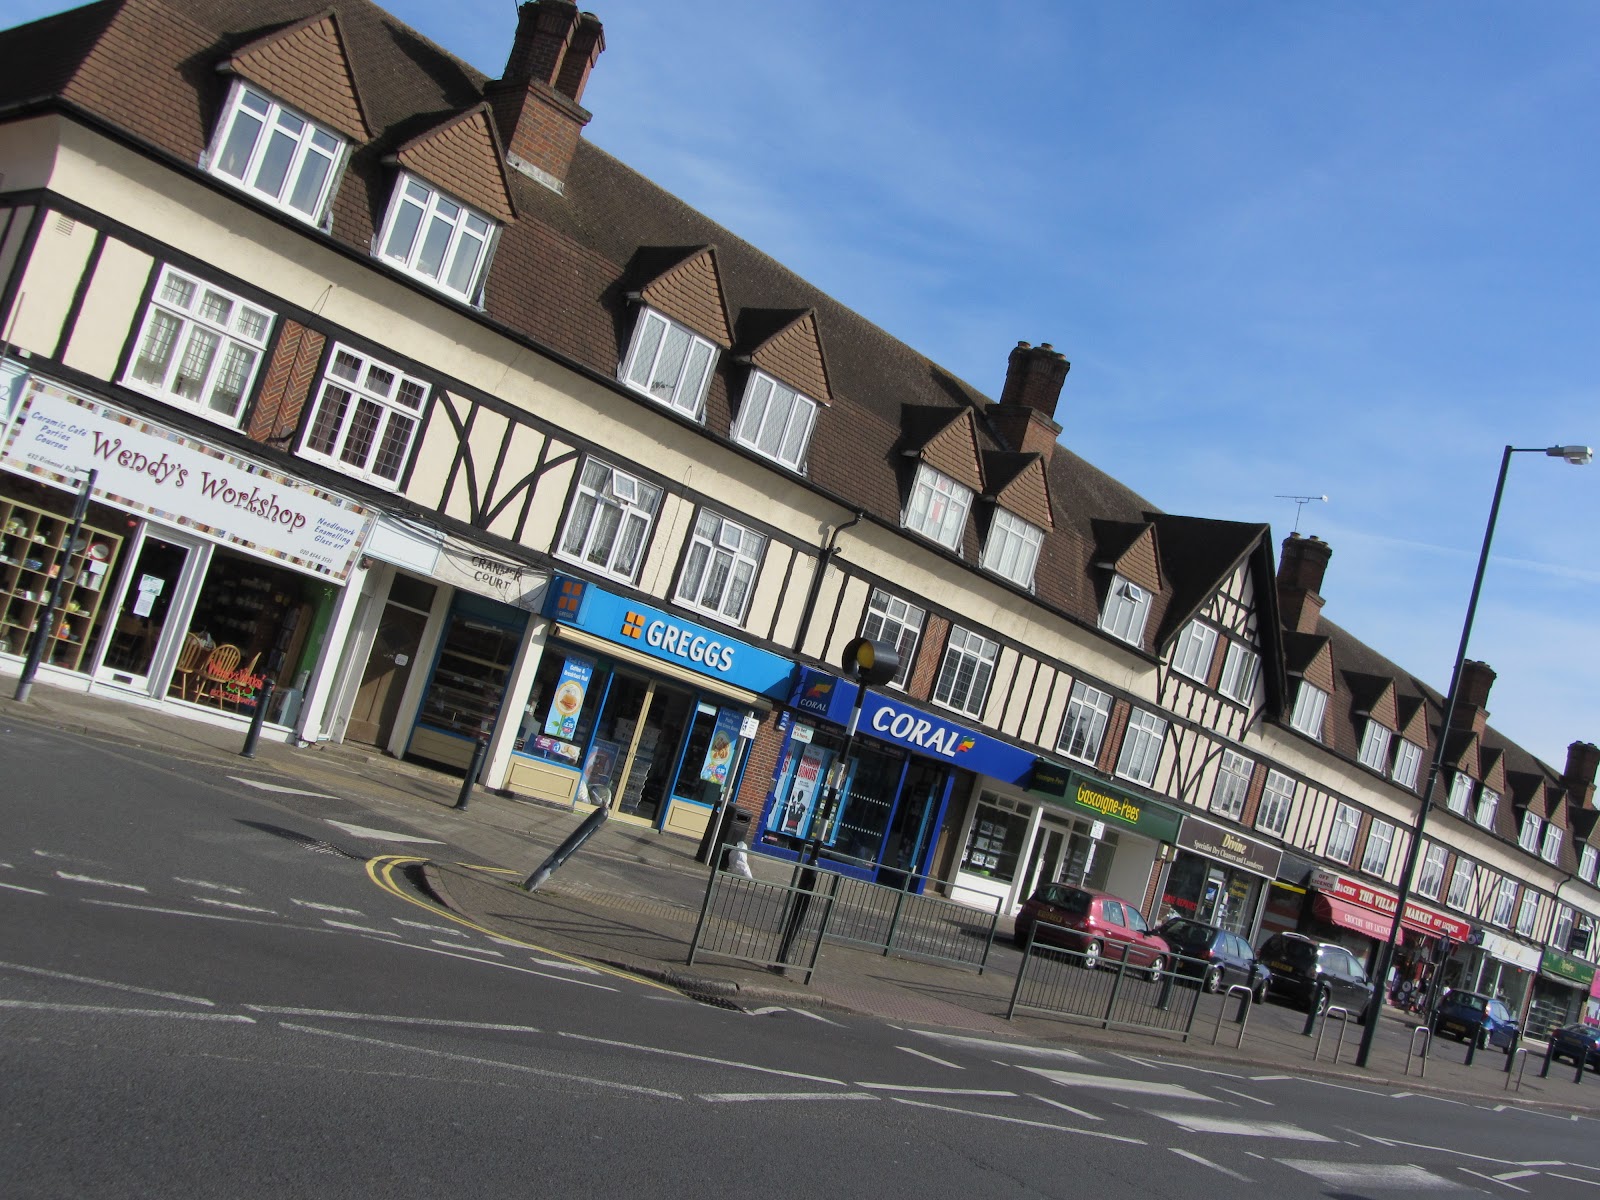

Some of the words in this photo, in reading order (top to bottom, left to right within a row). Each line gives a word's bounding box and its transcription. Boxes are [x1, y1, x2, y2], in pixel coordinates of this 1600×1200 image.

[31, 411, 66, 430] Ceramic
[67, 424, 88, 437] Café
[40, 425, 71, 441] Parties
[35, 433, 69, 451] Courses
[39, 455, 64, 469] Richmond
[92, 430, 188, 487] Wendy's
[201, 471, 306, 533] Workshop
[314, 525, 351, 545] Enamelling
[317, 517, 356, 536] Needlework
[314, 535, 333, 546] Glass
[474, 571, 511, 590] COURT
[646, 620, 735, 672] GREGGS
[569, 664, 581, 673] Coffee
[800, 698, 827, 712] CORAL
[872, 706, 959, 757] CORAL
[798, 764, 818, 782] BONUS
[1077, 782, 1140, 821] Gascoigne-Pees
[1194, 840, 1213, 852] Specialist
[1211, 847, 1220, 856] Dry
[1220, 850, 1236, 861] Cleaners
[1235, 856, 1244, 864] and
[1221, 833, 1247, 854] Divine
[1311, 879, 1333, 889] LICENCE
[1358, 888, 1374, 904] THE
[1374, 894, 1398, 913] VILLA
[1404, 906, 1433, 925] MARKET
[1433, 918, 1442, 928] OFF
[1441, 921, 1459, 934] LICENCE
[1344, 913, 1363, 928] GROCERY
[1365, 920, 1374, 931] OFF
